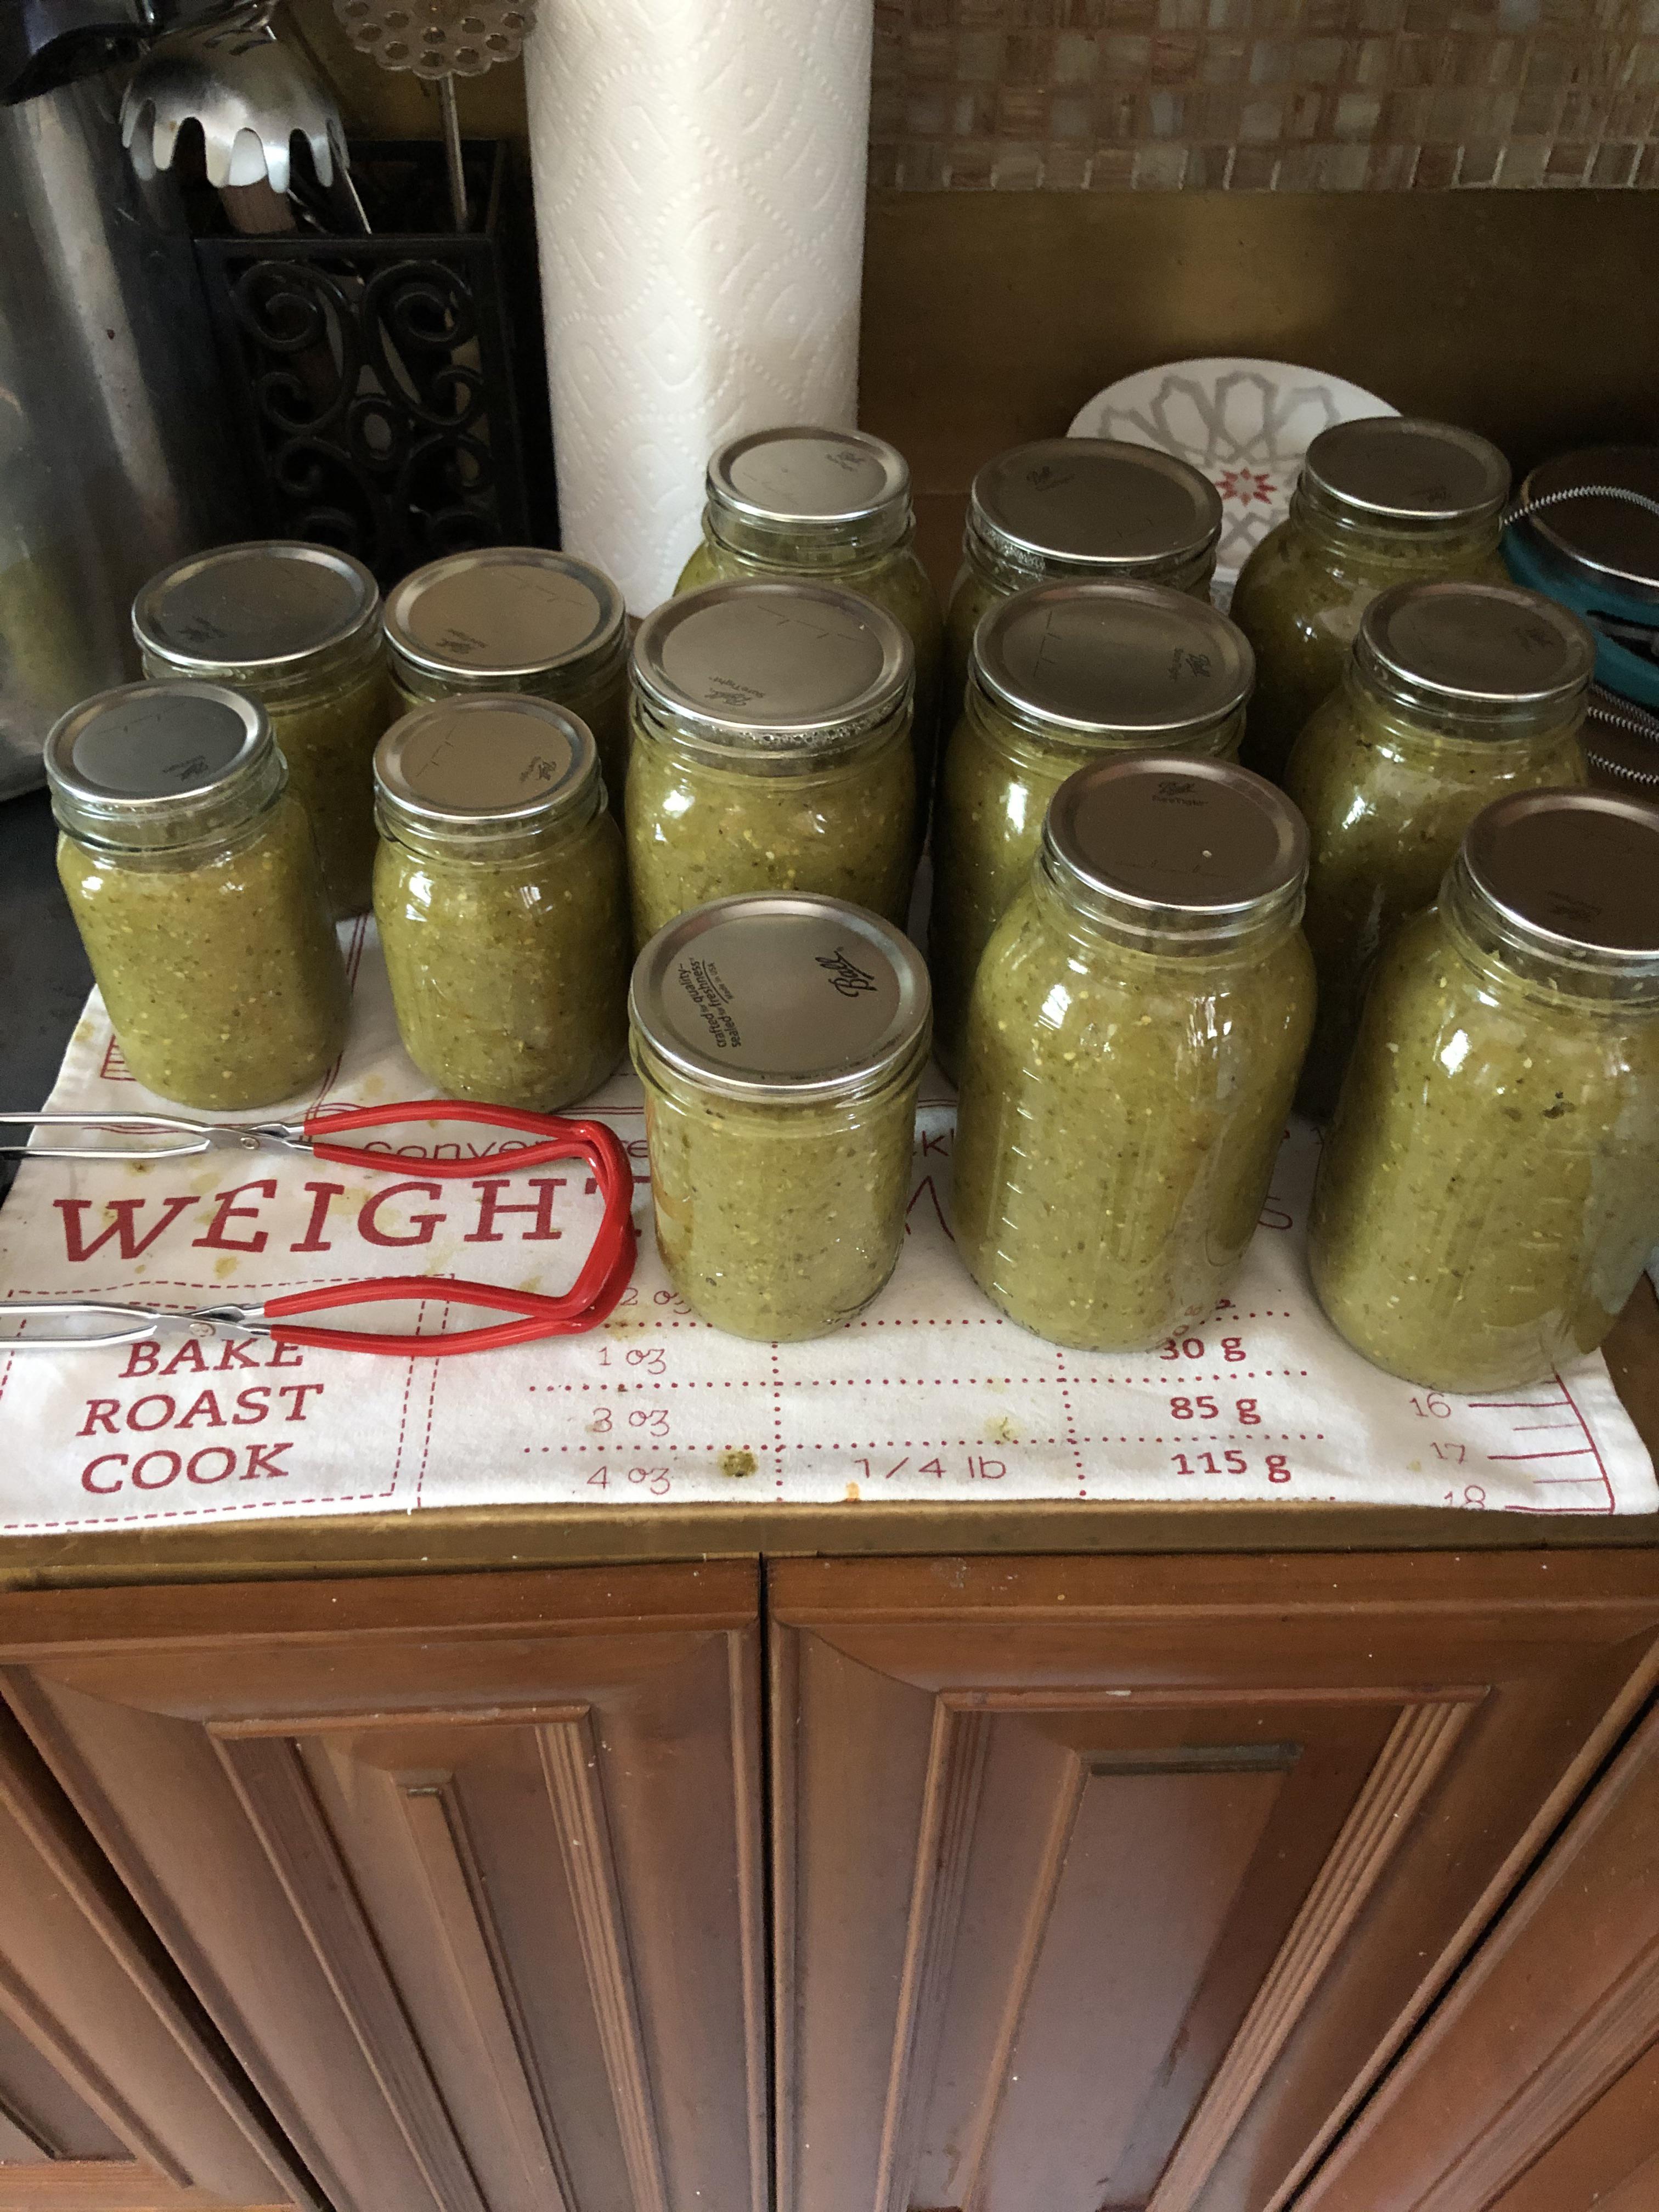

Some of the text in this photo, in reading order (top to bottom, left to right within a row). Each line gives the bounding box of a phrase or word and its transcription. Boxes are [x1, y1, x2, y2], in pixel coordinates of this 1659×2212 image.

[815, 950, 878, 997] Ball
[700, 1013, 727, 1048] crafted
[718, 1015, 742, 1048] sealed
[53, 1177, 651, 1262] WEIGH
[117, 1336, 303, 1379] BAKE
[599, 1346, 612, 1366] 1
[1159, 1336, 1247, 1363] 30 g
[76, 1383, 325, 1437] ROAST
[592, 1407, 613, 1433] 3
[1170, 1395, 1262, 1425] 85 g
[1409, 1391, 1452, 1419] 16
[80, 1442, 295, 1494] COOK
[968, 1455, 1007, 1480] lb
[1171, 1449, 1292, 1484] 115 g
[1430, 1441, 1466, 1465] 17
[586, 1465, 611, 1489] 4
[1443, 1484, 1486, 1510] 18
